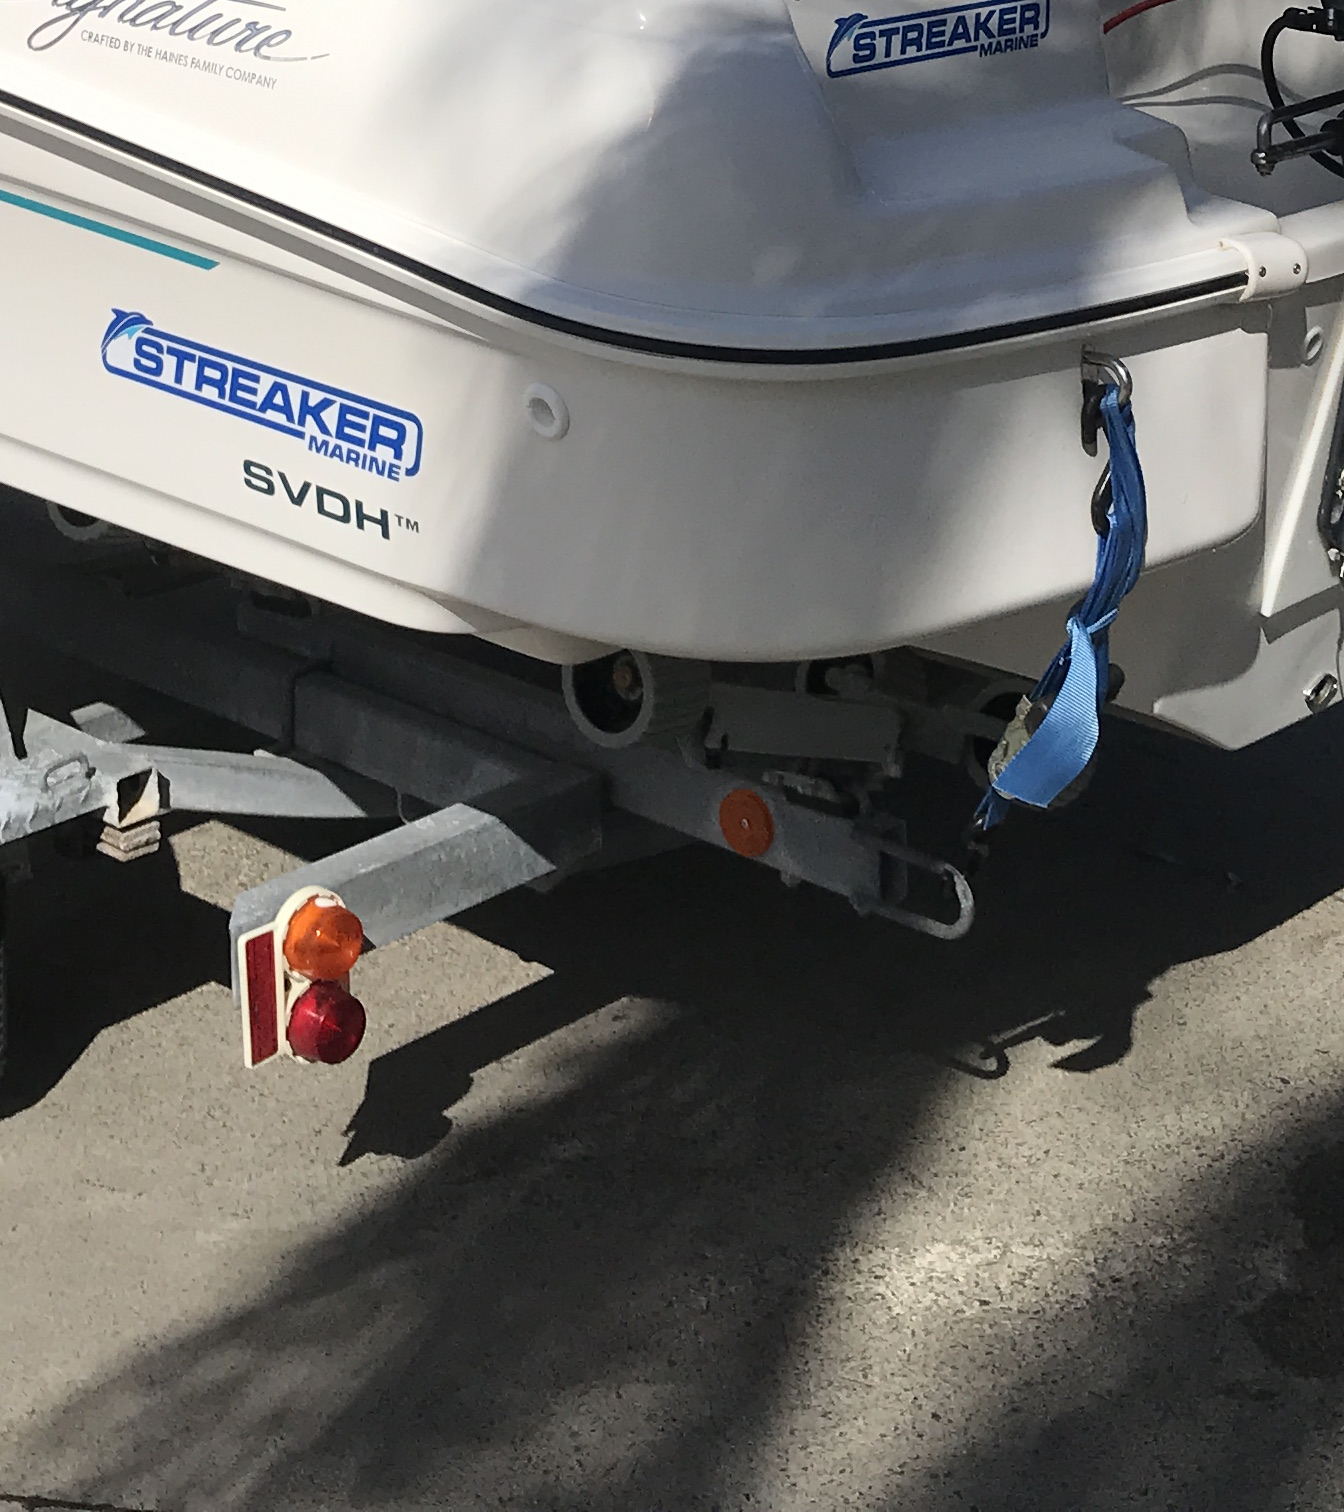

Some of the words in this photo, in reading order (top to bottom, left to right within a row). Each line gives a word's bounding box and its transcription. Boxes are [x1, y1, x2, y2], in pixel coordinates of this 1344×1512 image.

[80, 29, 122, 51] CRAFTED
[123, 39, 136, 53] BY
[137, 43, 153, 58] THE
[154, 47, 189, 68] HAINES
[190, 57, 224, 76] FAMILY
[225, 66, 278, 90] COMPANY
[851, 1, 1041, 65] STREAKER
[978, 35, 1040, 59] MARINE
[133, 336, 408, 460] STREAKER
[308, 434, 401, 482] MARINE
[242, 459, 390, 540] SVDH
